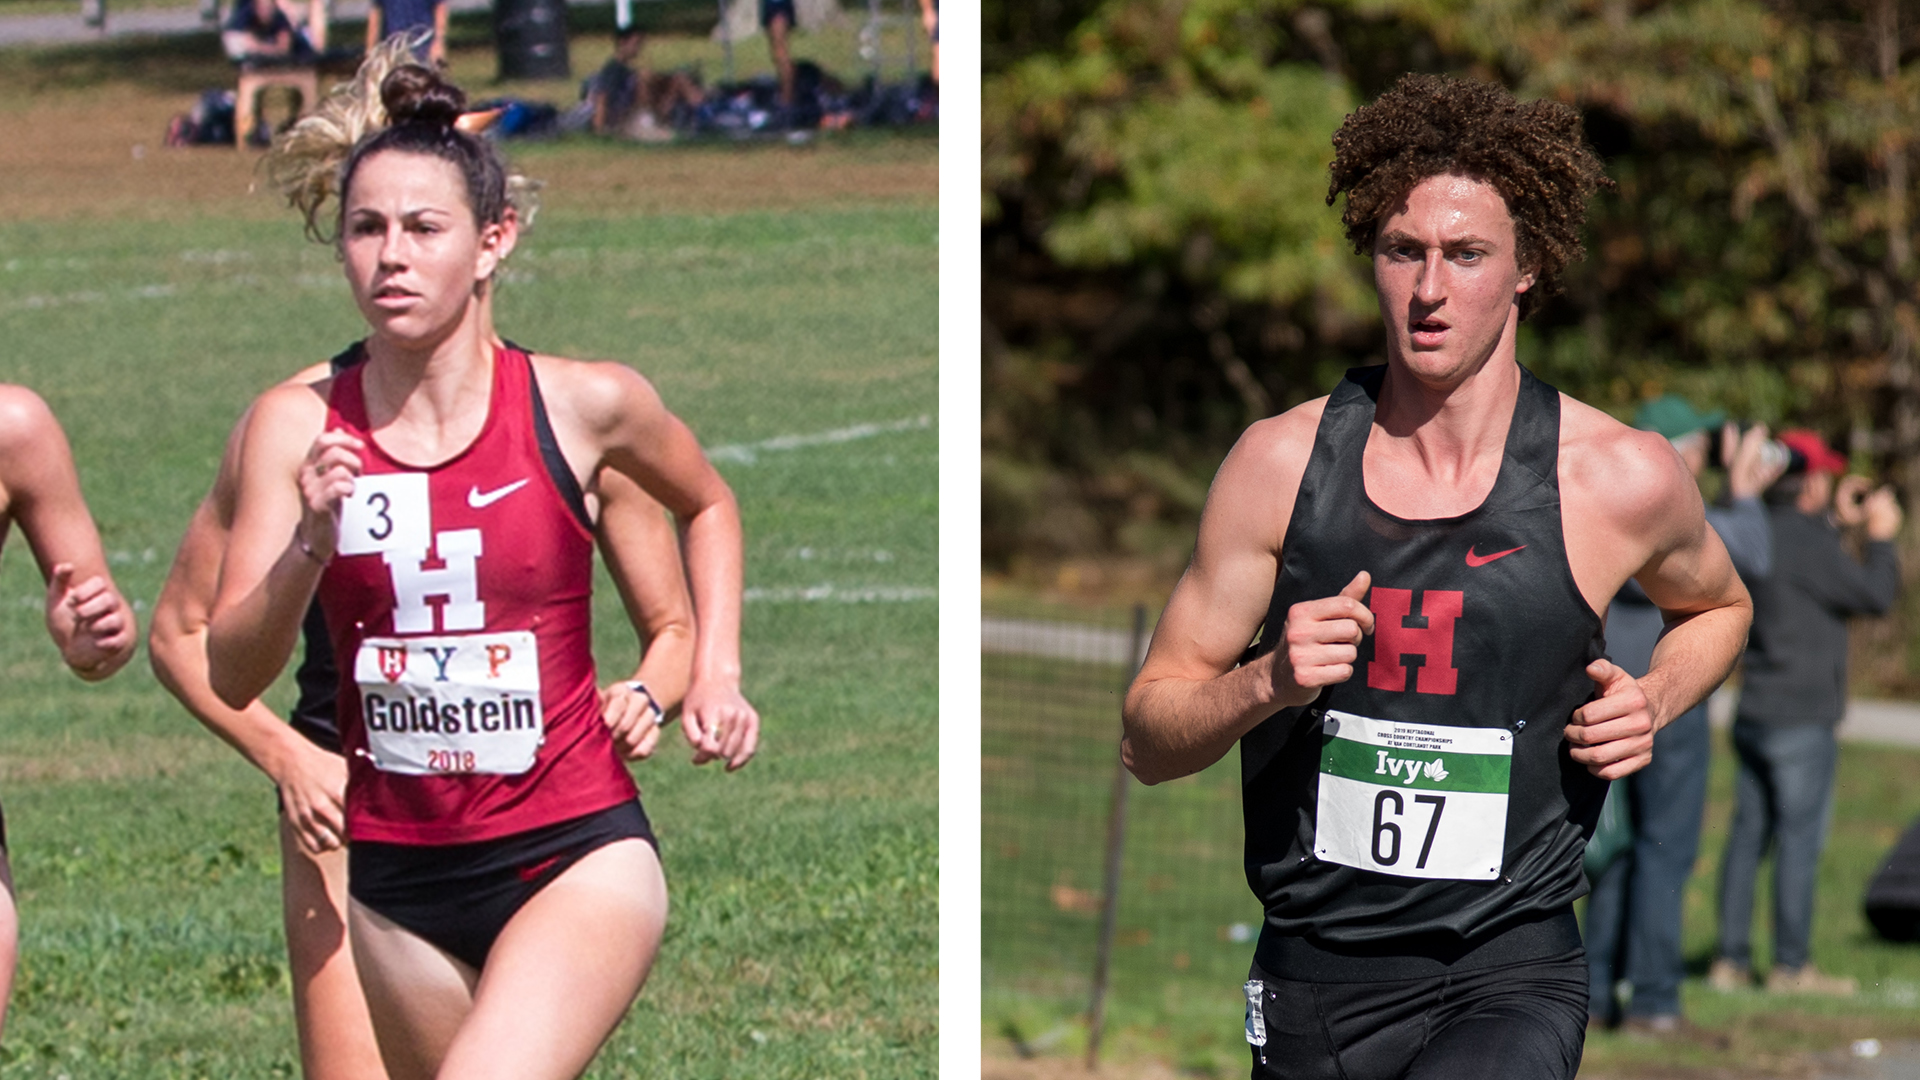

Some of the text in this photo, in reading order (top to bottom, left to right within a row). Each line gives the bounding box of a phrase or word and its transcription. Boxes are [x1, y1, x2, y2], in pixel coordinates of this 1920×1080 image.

[367, 491, 393, 541] 3
[381, 528, 485, 633] H
[1367, 586, 1464, 695] H
[422, 646, 457, 682] Y
[485, 643, 512, 679] P
[365, 692, 536, 734] Goldstein
[1407, 728, 1435, 736] HEPTAGONAL
[1415, 736, 1453, 744] CHAMPIONSHIPS
[427, 750, 476, 772] 2018
[1375, 750, 1424, 785] Ivy
[1371, 789, 1447, 869] 67
